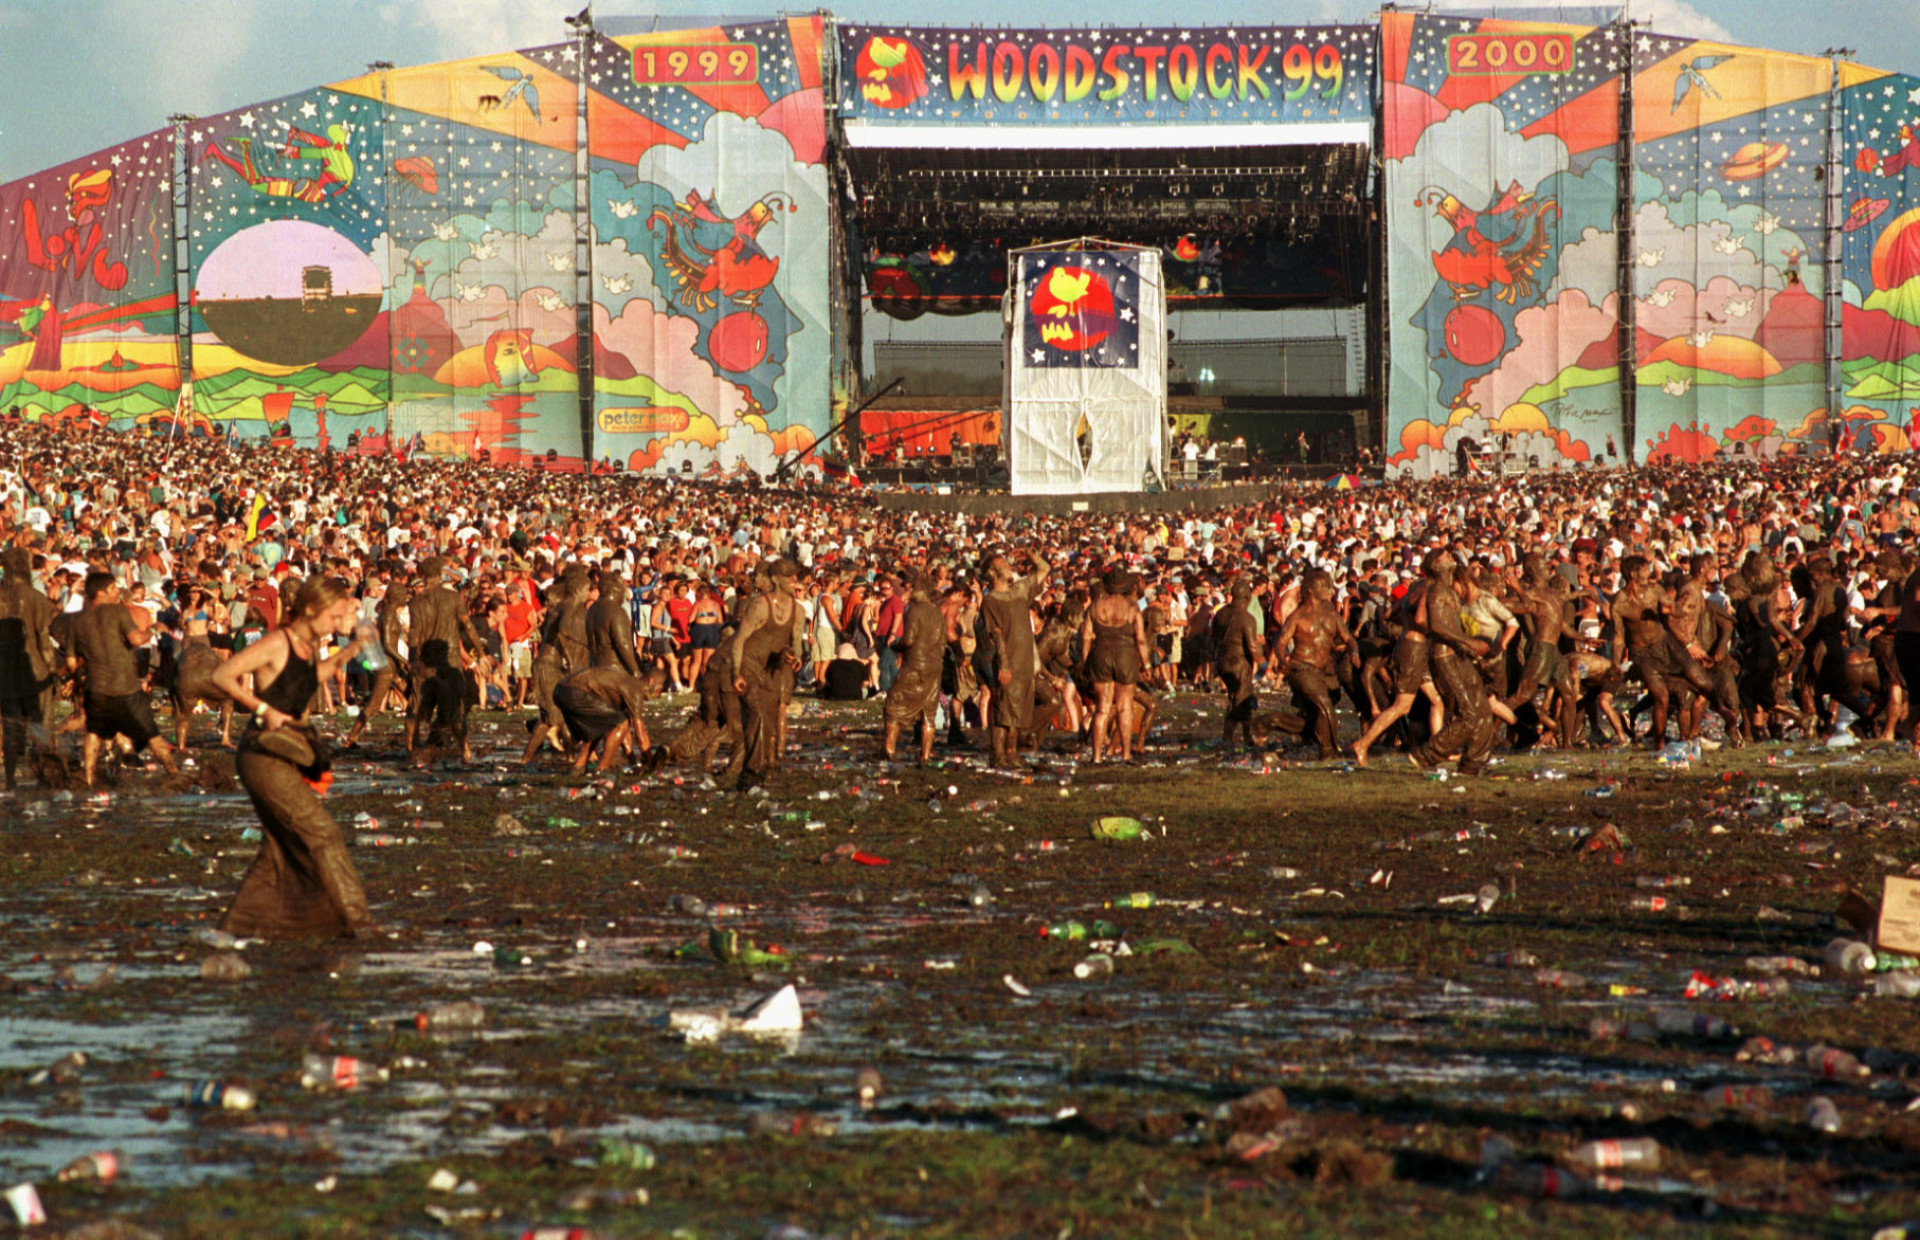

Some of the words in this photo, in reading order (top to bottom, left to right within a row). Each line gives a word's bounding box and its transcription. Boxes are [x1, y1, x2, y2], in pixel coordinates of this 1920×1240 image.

[642, 49, 749, 78] 1999
[1456, 38, 1566, 68] 2000
[948, 41, 1271, 104] WOODSTOCK
[1282, 43, 1344, 100] 99
[603, 410, 646, 430] peter
